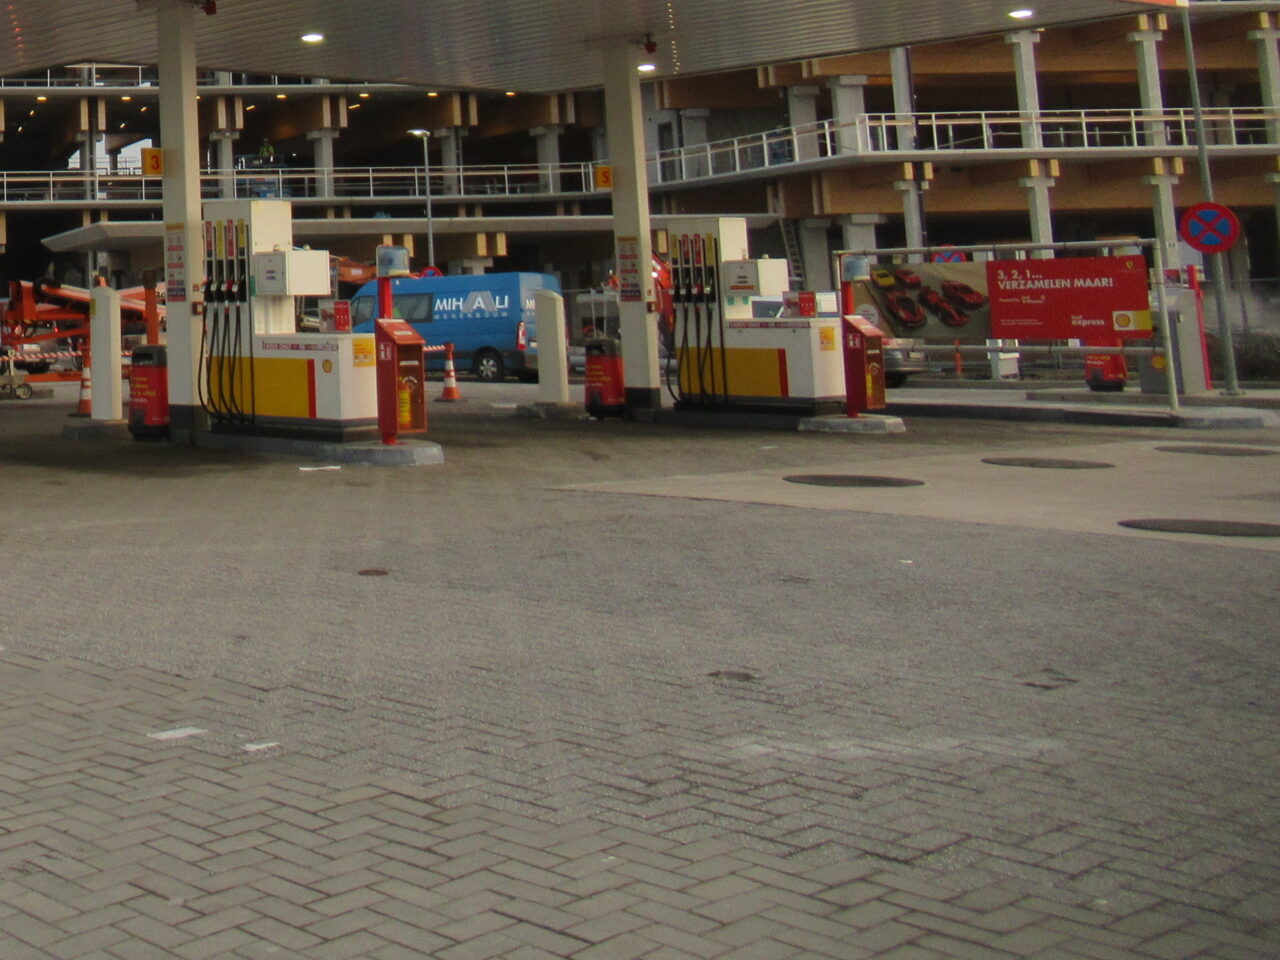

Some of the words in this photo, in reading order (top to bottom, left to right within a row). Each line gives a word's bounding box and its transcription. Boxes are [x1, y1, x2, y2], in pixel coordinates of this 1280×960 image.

[150, 155, 160, 171] 3
[602, 171, 610, 184] 5
[997, 279, 1071, 290] VERZAMELEN
[1073, 277, 1114, 288] MAAR!
[434, 295, 509, 312] MIHALI
